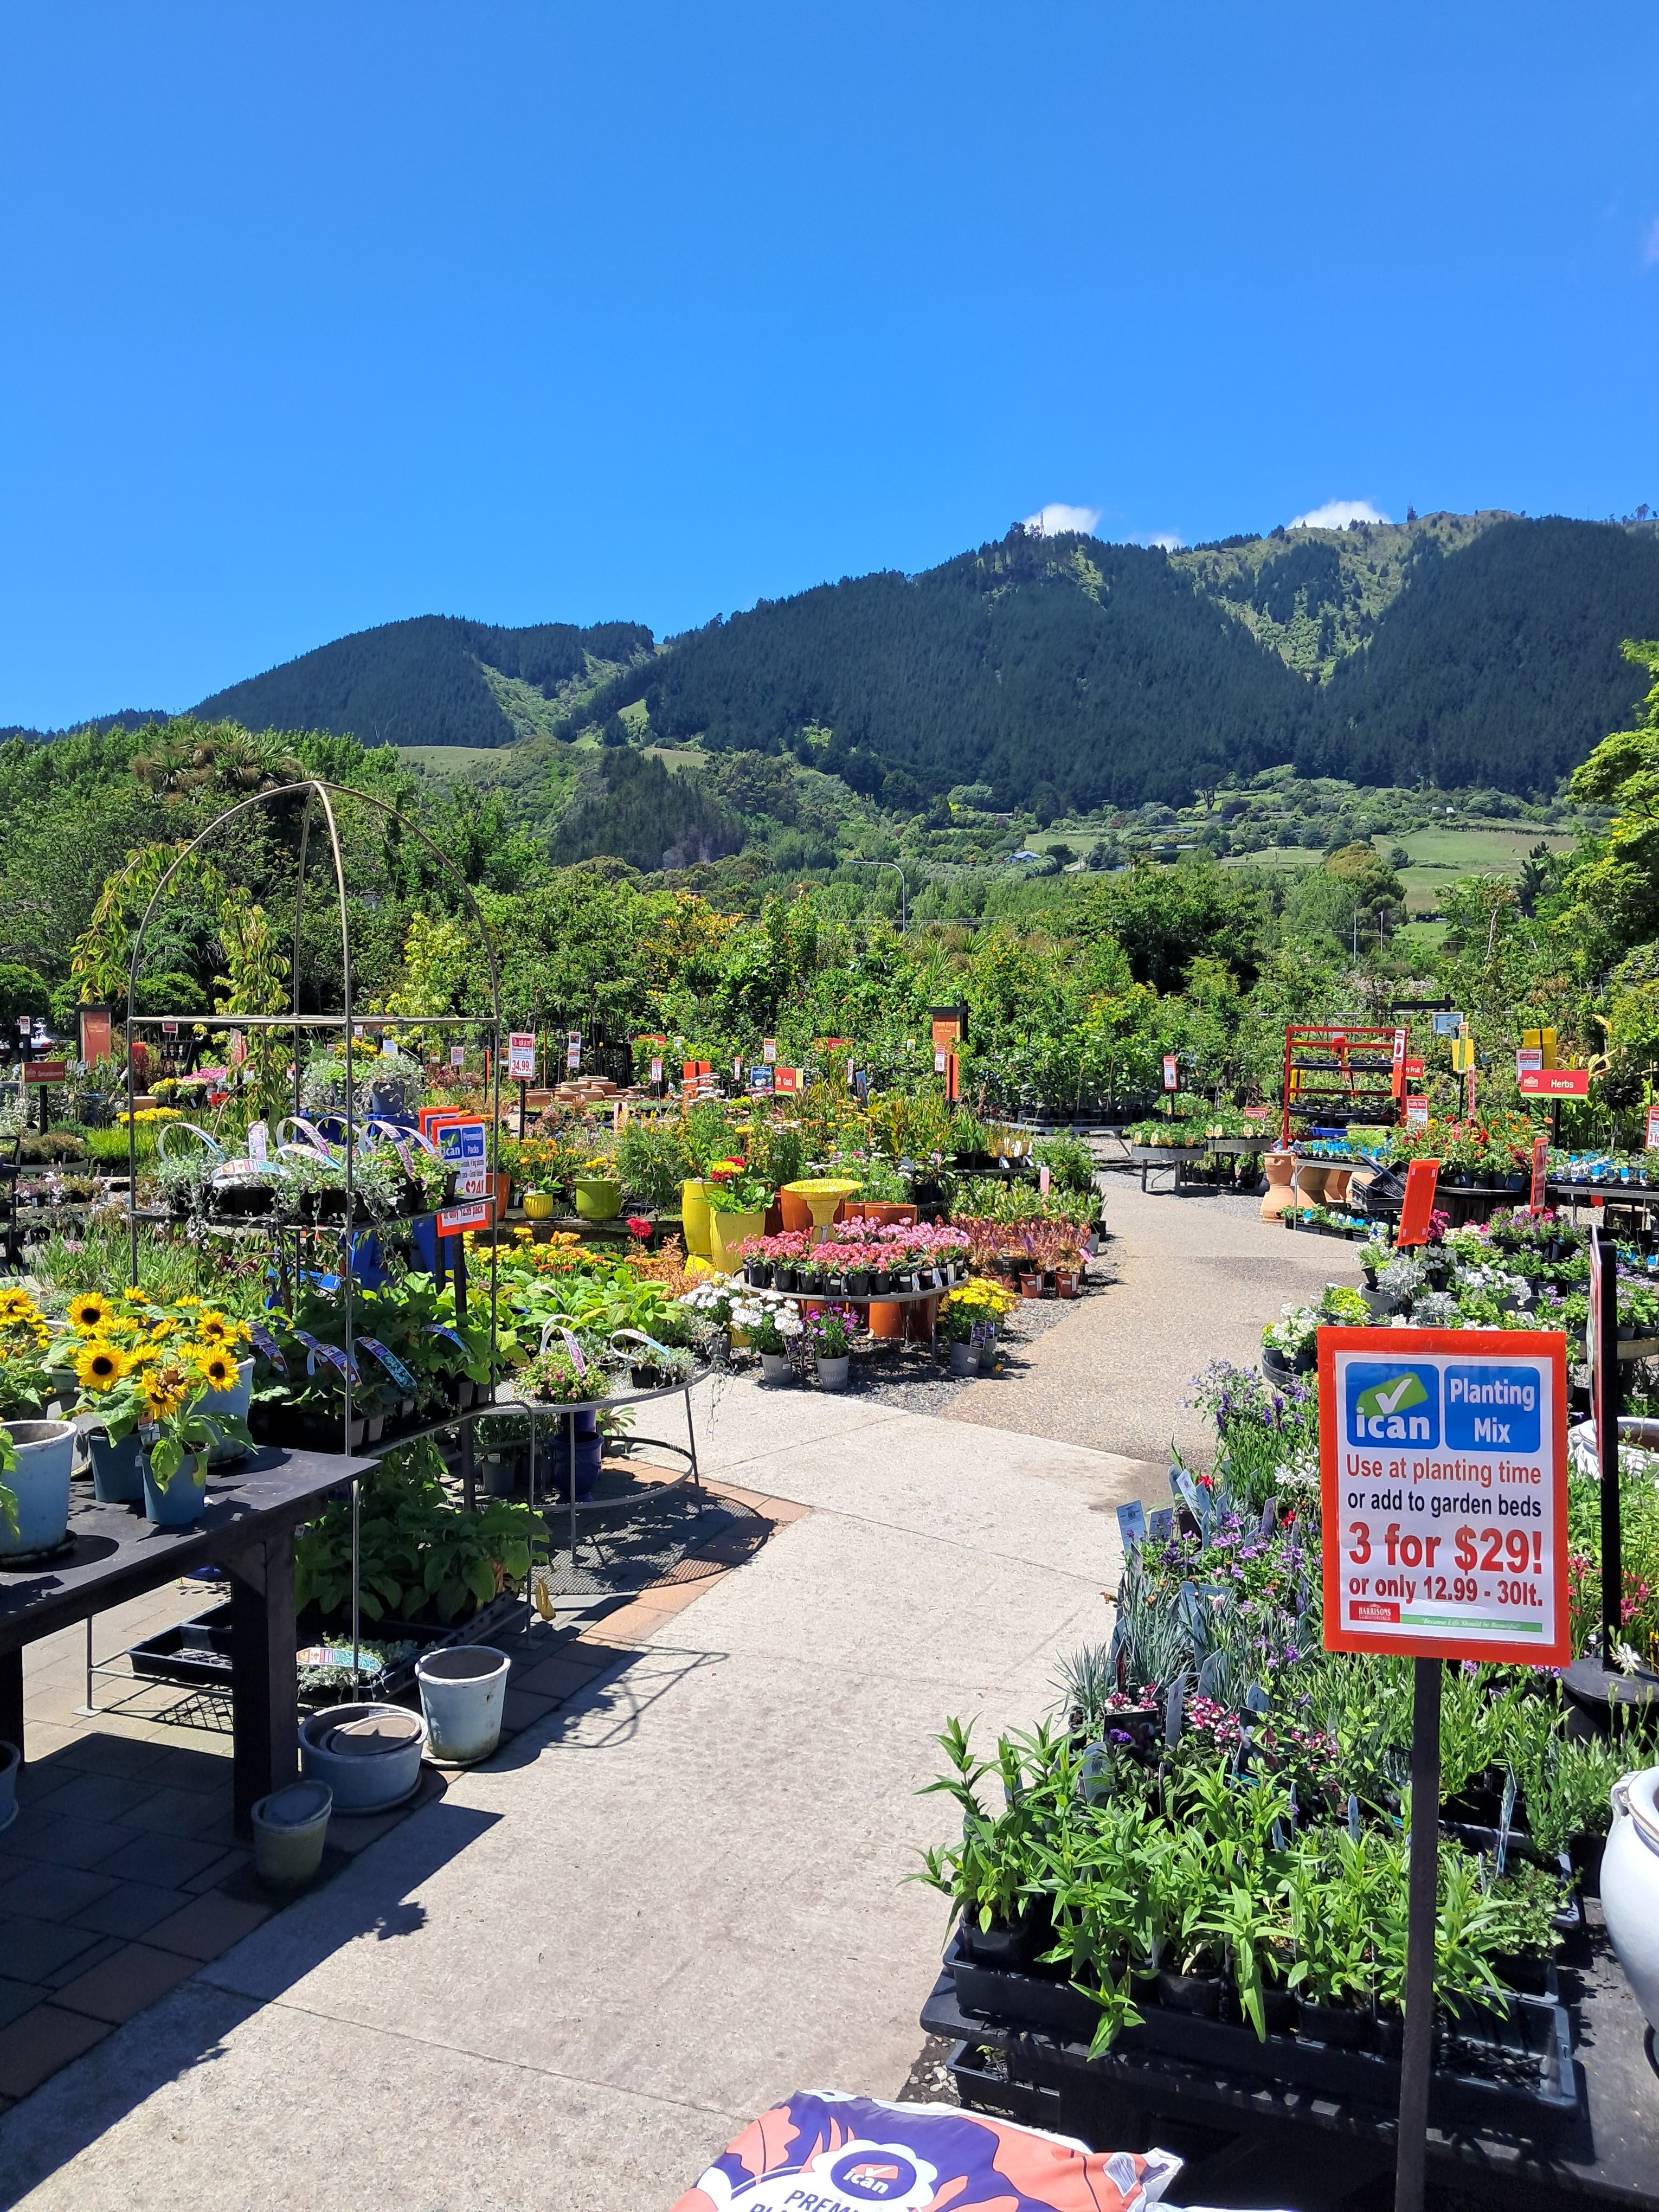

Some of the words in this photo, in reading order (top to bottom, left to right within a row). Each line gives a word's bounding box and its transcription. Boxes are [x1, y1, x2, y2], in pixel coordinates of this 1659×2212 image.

[512, 1059, 529, 1071] 34.99
[1551, 1079, 1574, 1089] Herbs
[1450, 1377, 1535, 1412] Planting
[1356, 1406, 1430, 1441] ican
[1474, 1417, 1511, 1444] Mix
[1347, 1454, 1382, 1478] Use
[1388, 1457, 1407, 1479] at
[1412, 1457, 1491, 1488] planting
[1498, 1460, 1541, 1485] time
[1348, 1491, 1366, 1509] or
[1371, 1488, 1403, 1511] add
[1408, 1490, 1425, 1512] to
[1431, 1492, 1491, 1518] garden
[1498, 1493, 1542, 1517] beds
[1348, 1521, 1371, 1565] 3
[1384, 1523, 1442, 1568] for
[1454, 1524, 1542, 1576] $29!
[1349, 1577, 1369, 1596] or
[1375, 1574, 1417, 1604] only
[1423, 1576, 1478, 1602] 12.99
[1497, 1579, 1543, 1607] 30lt.
[1358, 1607, 1391, 1617] HARRISONS
[842, 2168, 889, 2195] ican
